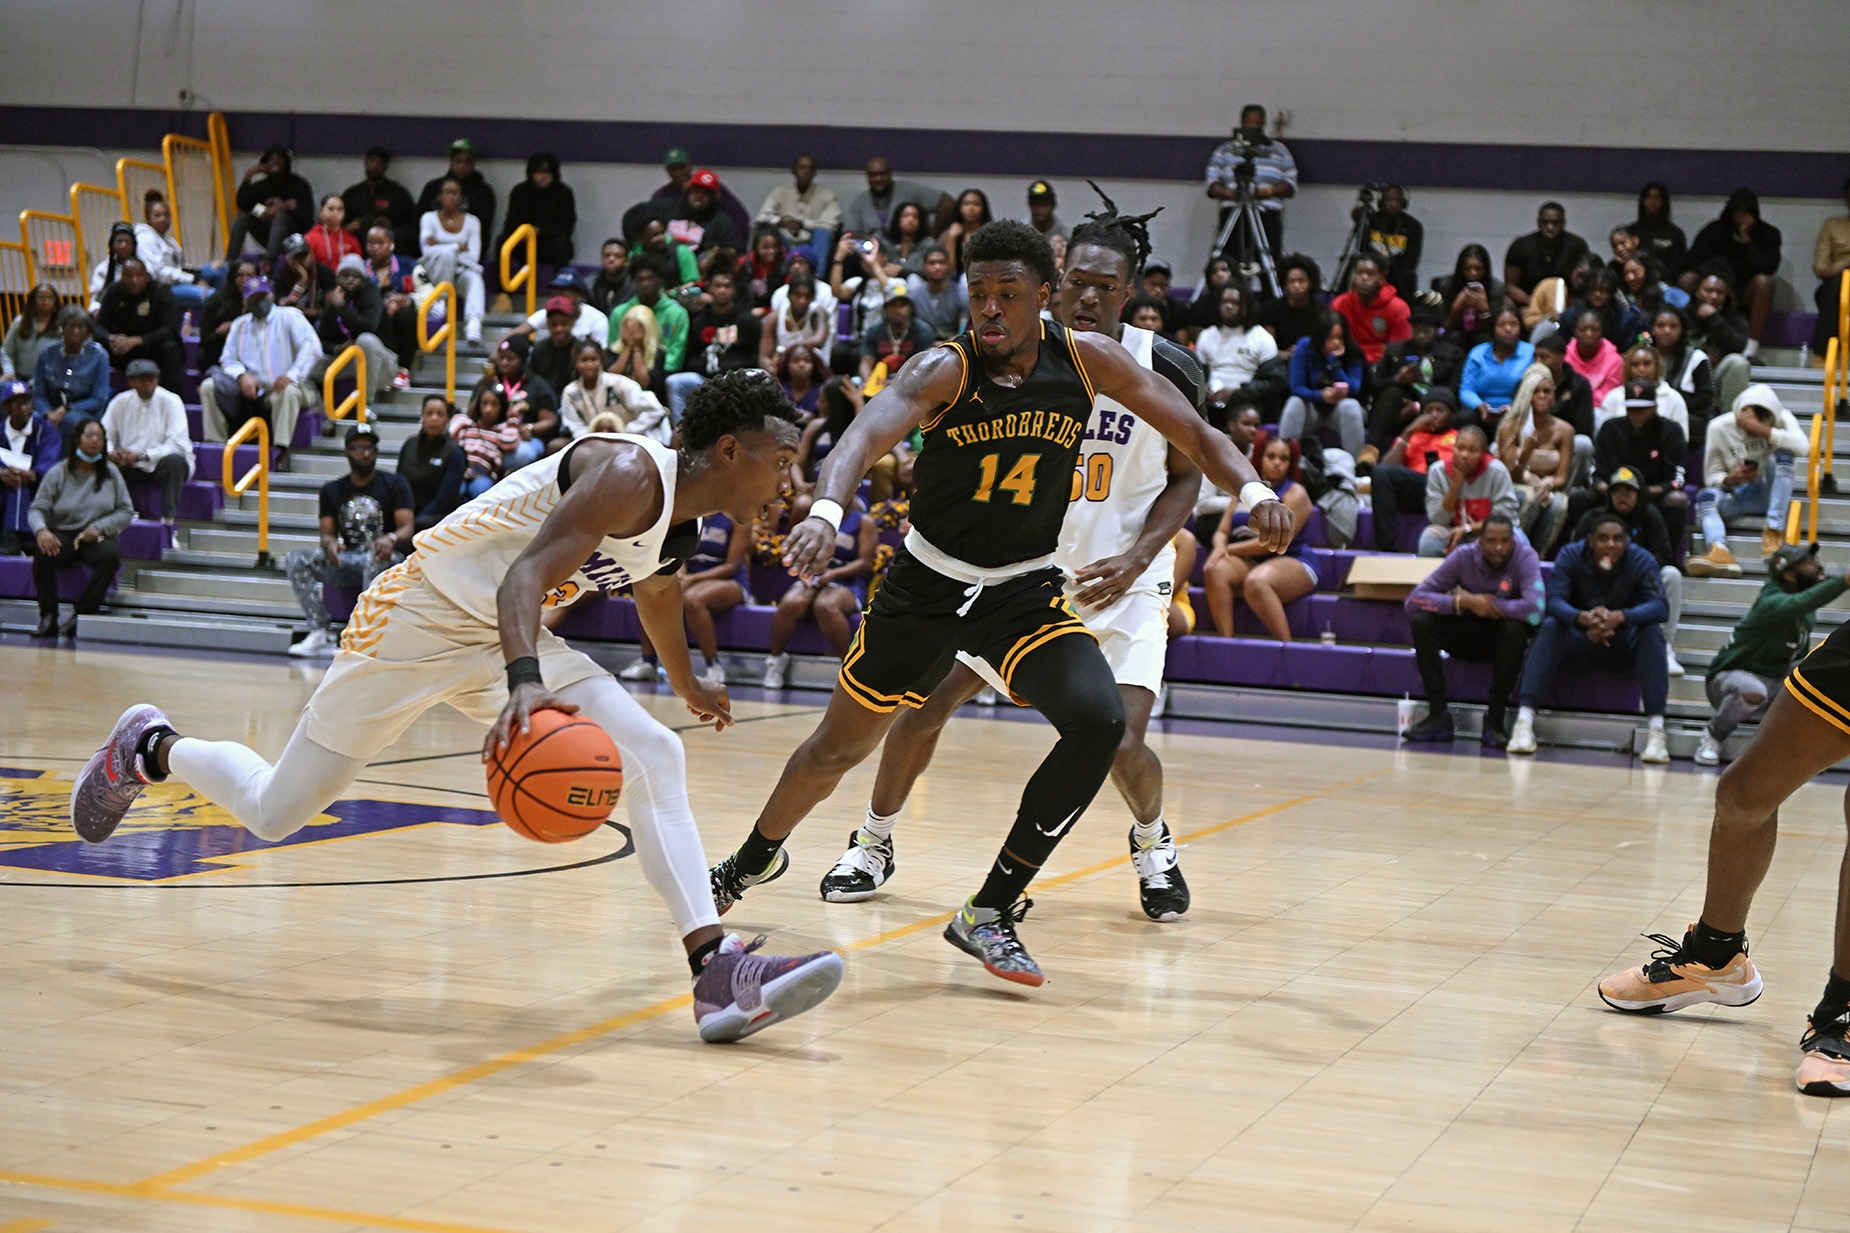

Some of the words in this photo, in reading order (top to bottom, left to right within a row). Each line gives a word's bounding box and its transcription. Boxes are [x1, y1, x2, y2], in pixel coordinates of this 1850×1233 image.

[945, 410, 1082, 449] THOROBREDS
[970, 452, 1042, 506] 14
[567, 786, 621, 806] ELITE
